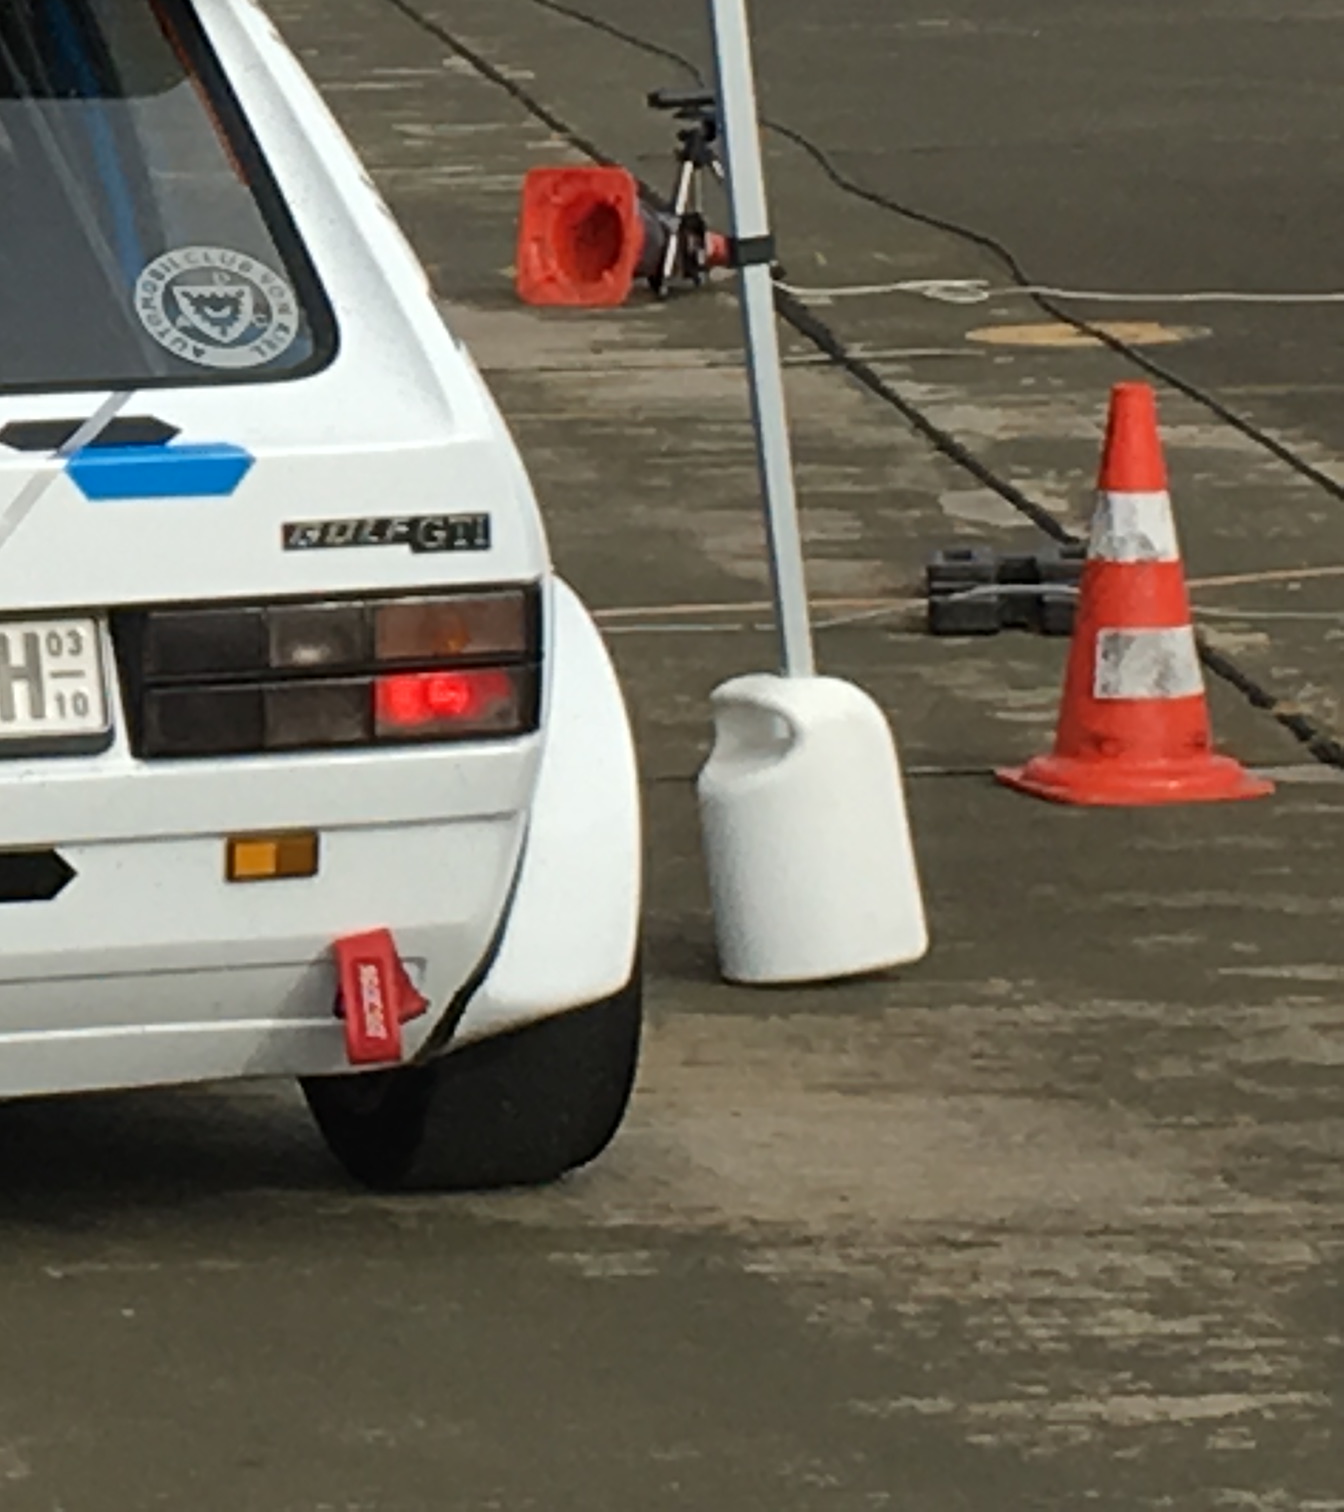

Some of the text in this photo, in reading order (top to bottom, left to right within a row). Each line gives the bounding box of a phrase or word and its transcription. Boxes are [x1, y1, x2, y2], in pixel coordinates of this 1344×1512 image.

[416, 515, 488, 549] GTI
[46, 630, 84, 658] 03
[52, 691, 90, 719] 10
